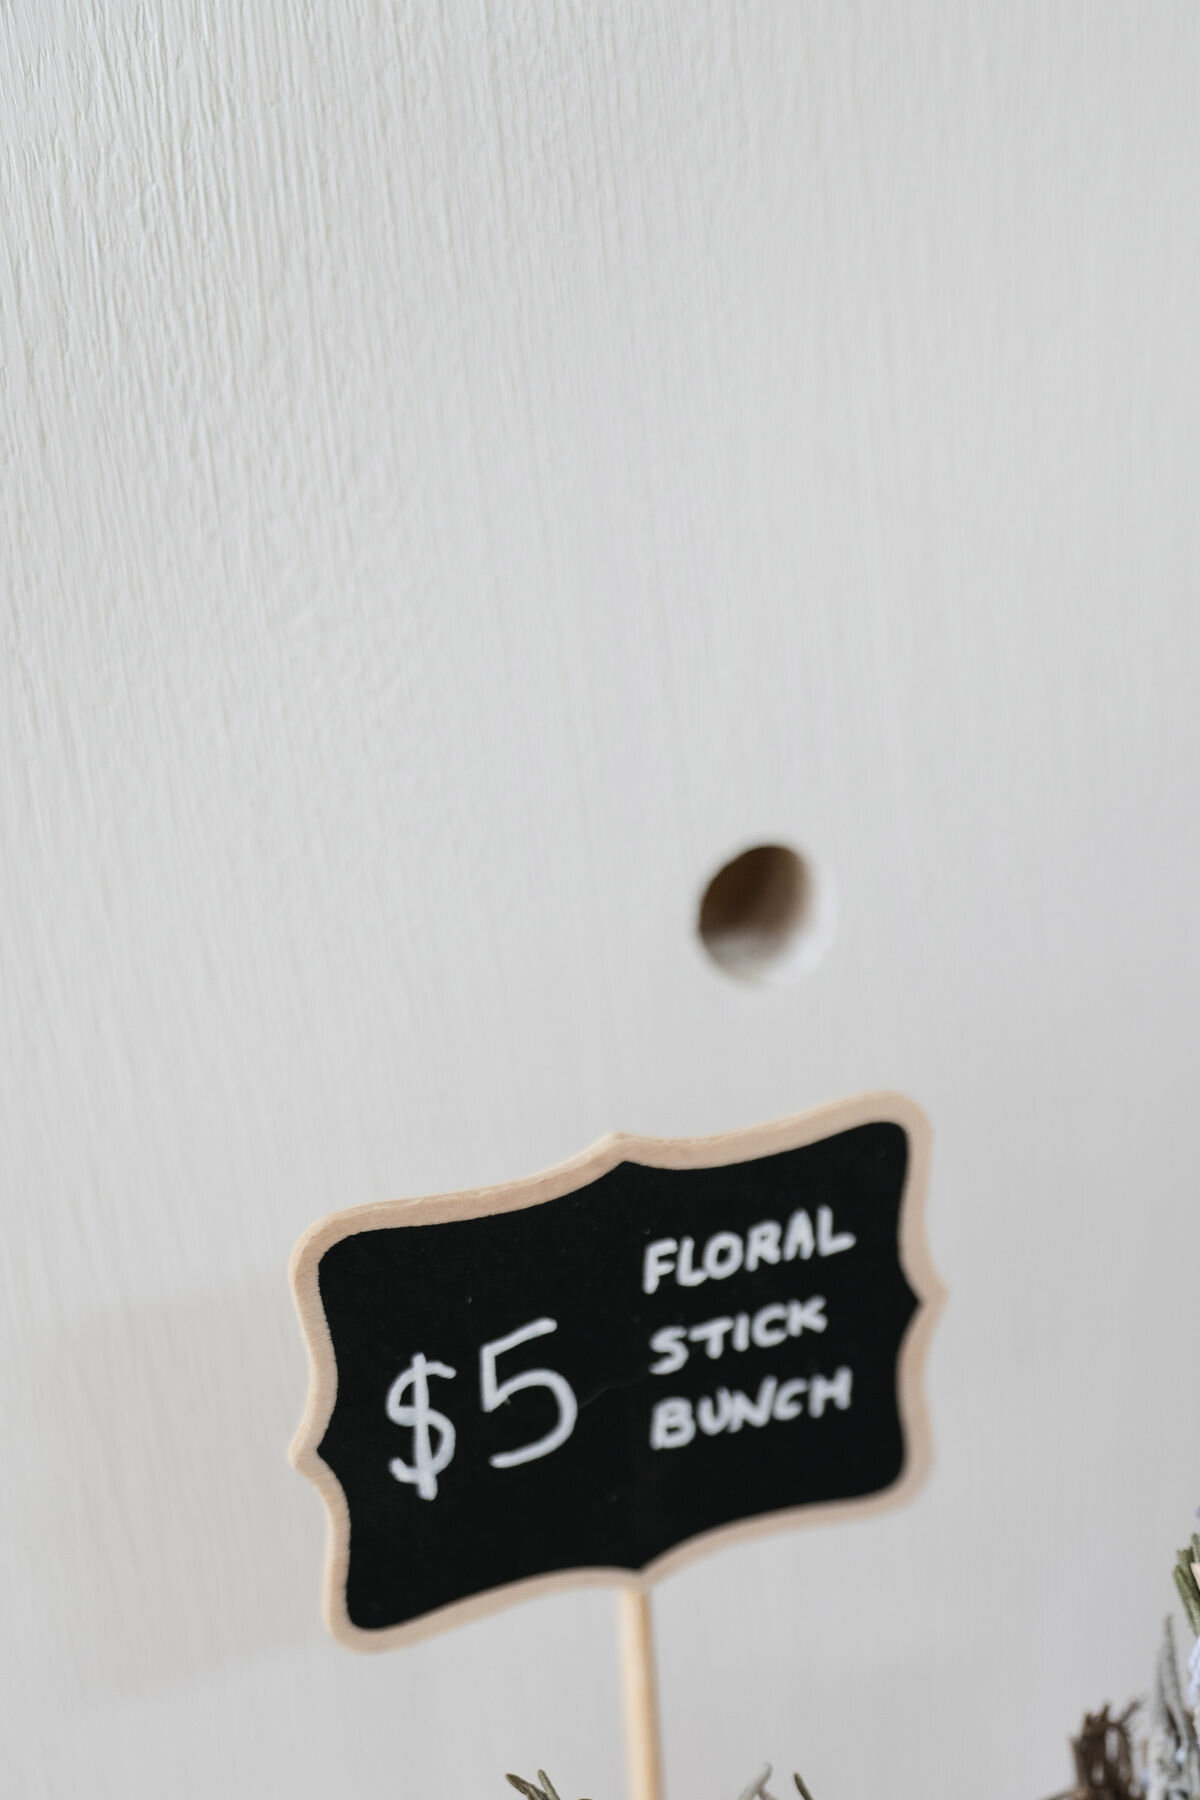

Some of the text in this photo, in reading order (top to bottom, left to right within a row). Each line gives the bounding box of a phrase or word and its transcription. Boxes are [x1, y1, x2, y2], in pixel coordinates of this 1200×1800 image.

[643, 1206, 856, 1294] FLORAL
[650, 1296, 828, 1375] STICK
[386, 1318, 578, 1500] $5
[651, 1367, 853, 1449] BUNCH
